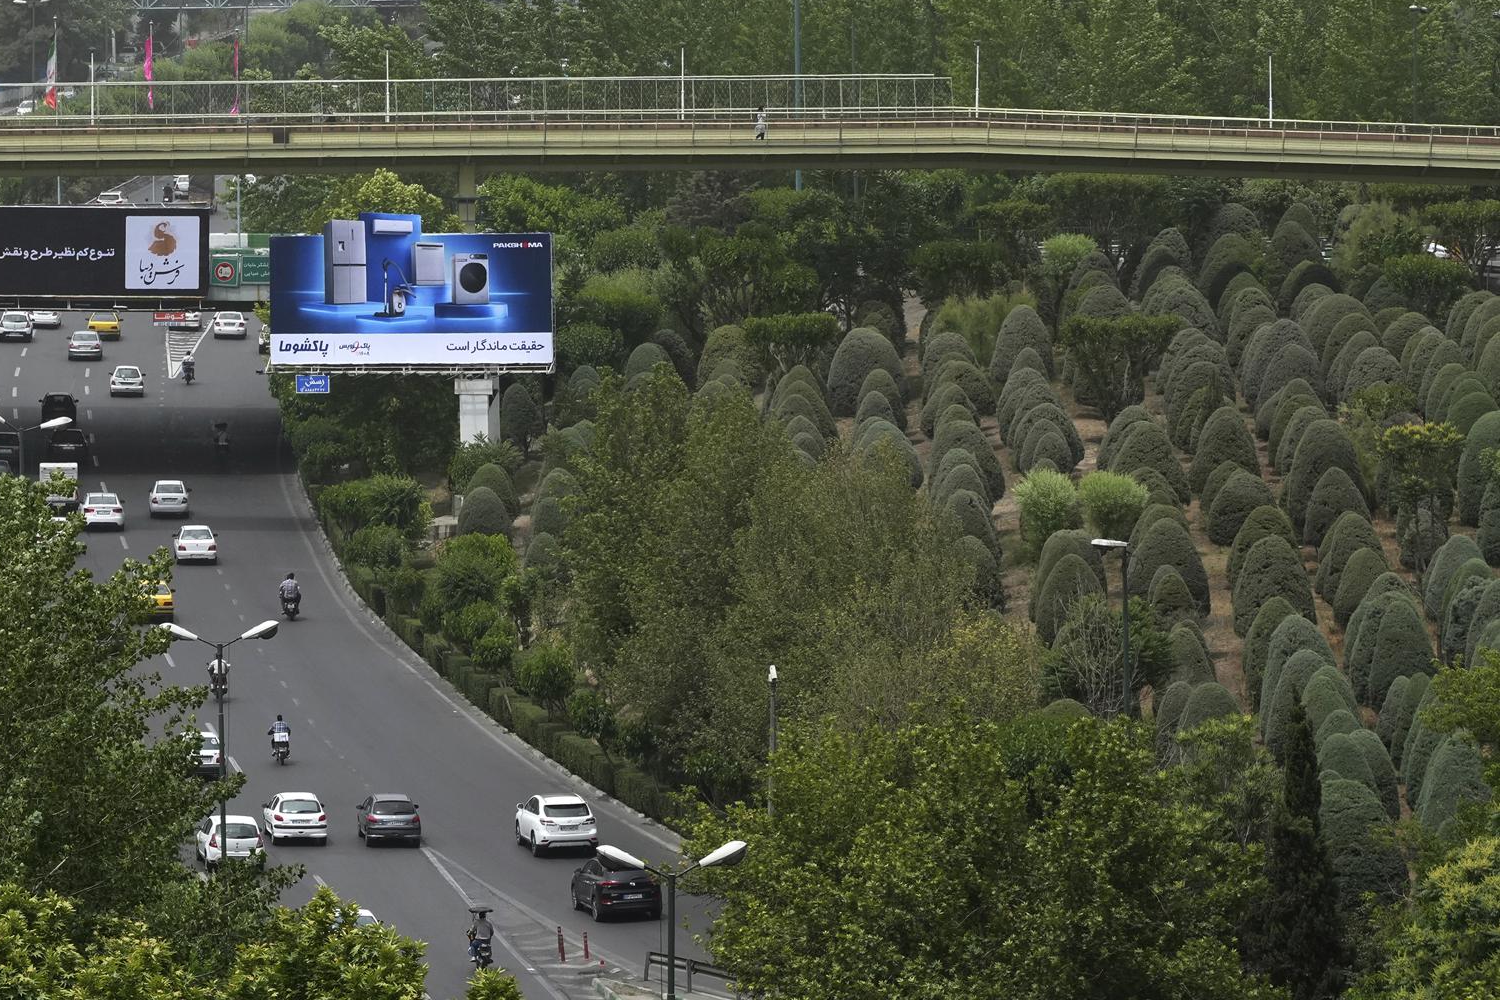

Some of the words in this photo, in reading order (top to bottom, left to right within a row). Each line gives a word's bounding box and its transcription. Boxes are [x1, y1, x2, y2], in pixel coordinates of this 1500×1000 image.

[23, 249, 29, 259] و
[30, 247, 53, 261] طرح
[52, 247, 76, 260] نظیر
[76, 247, 90, 261] کم
[89, 247, 115, 261] تنوع
[143, 258, 185, 285] فرش
[278, 337, 329, 358] پاکشوما
[446, 341, 470, 351] است
[471, 339, 508, 354] ماندگار
[509, 340, 545, 353] حقیقت
